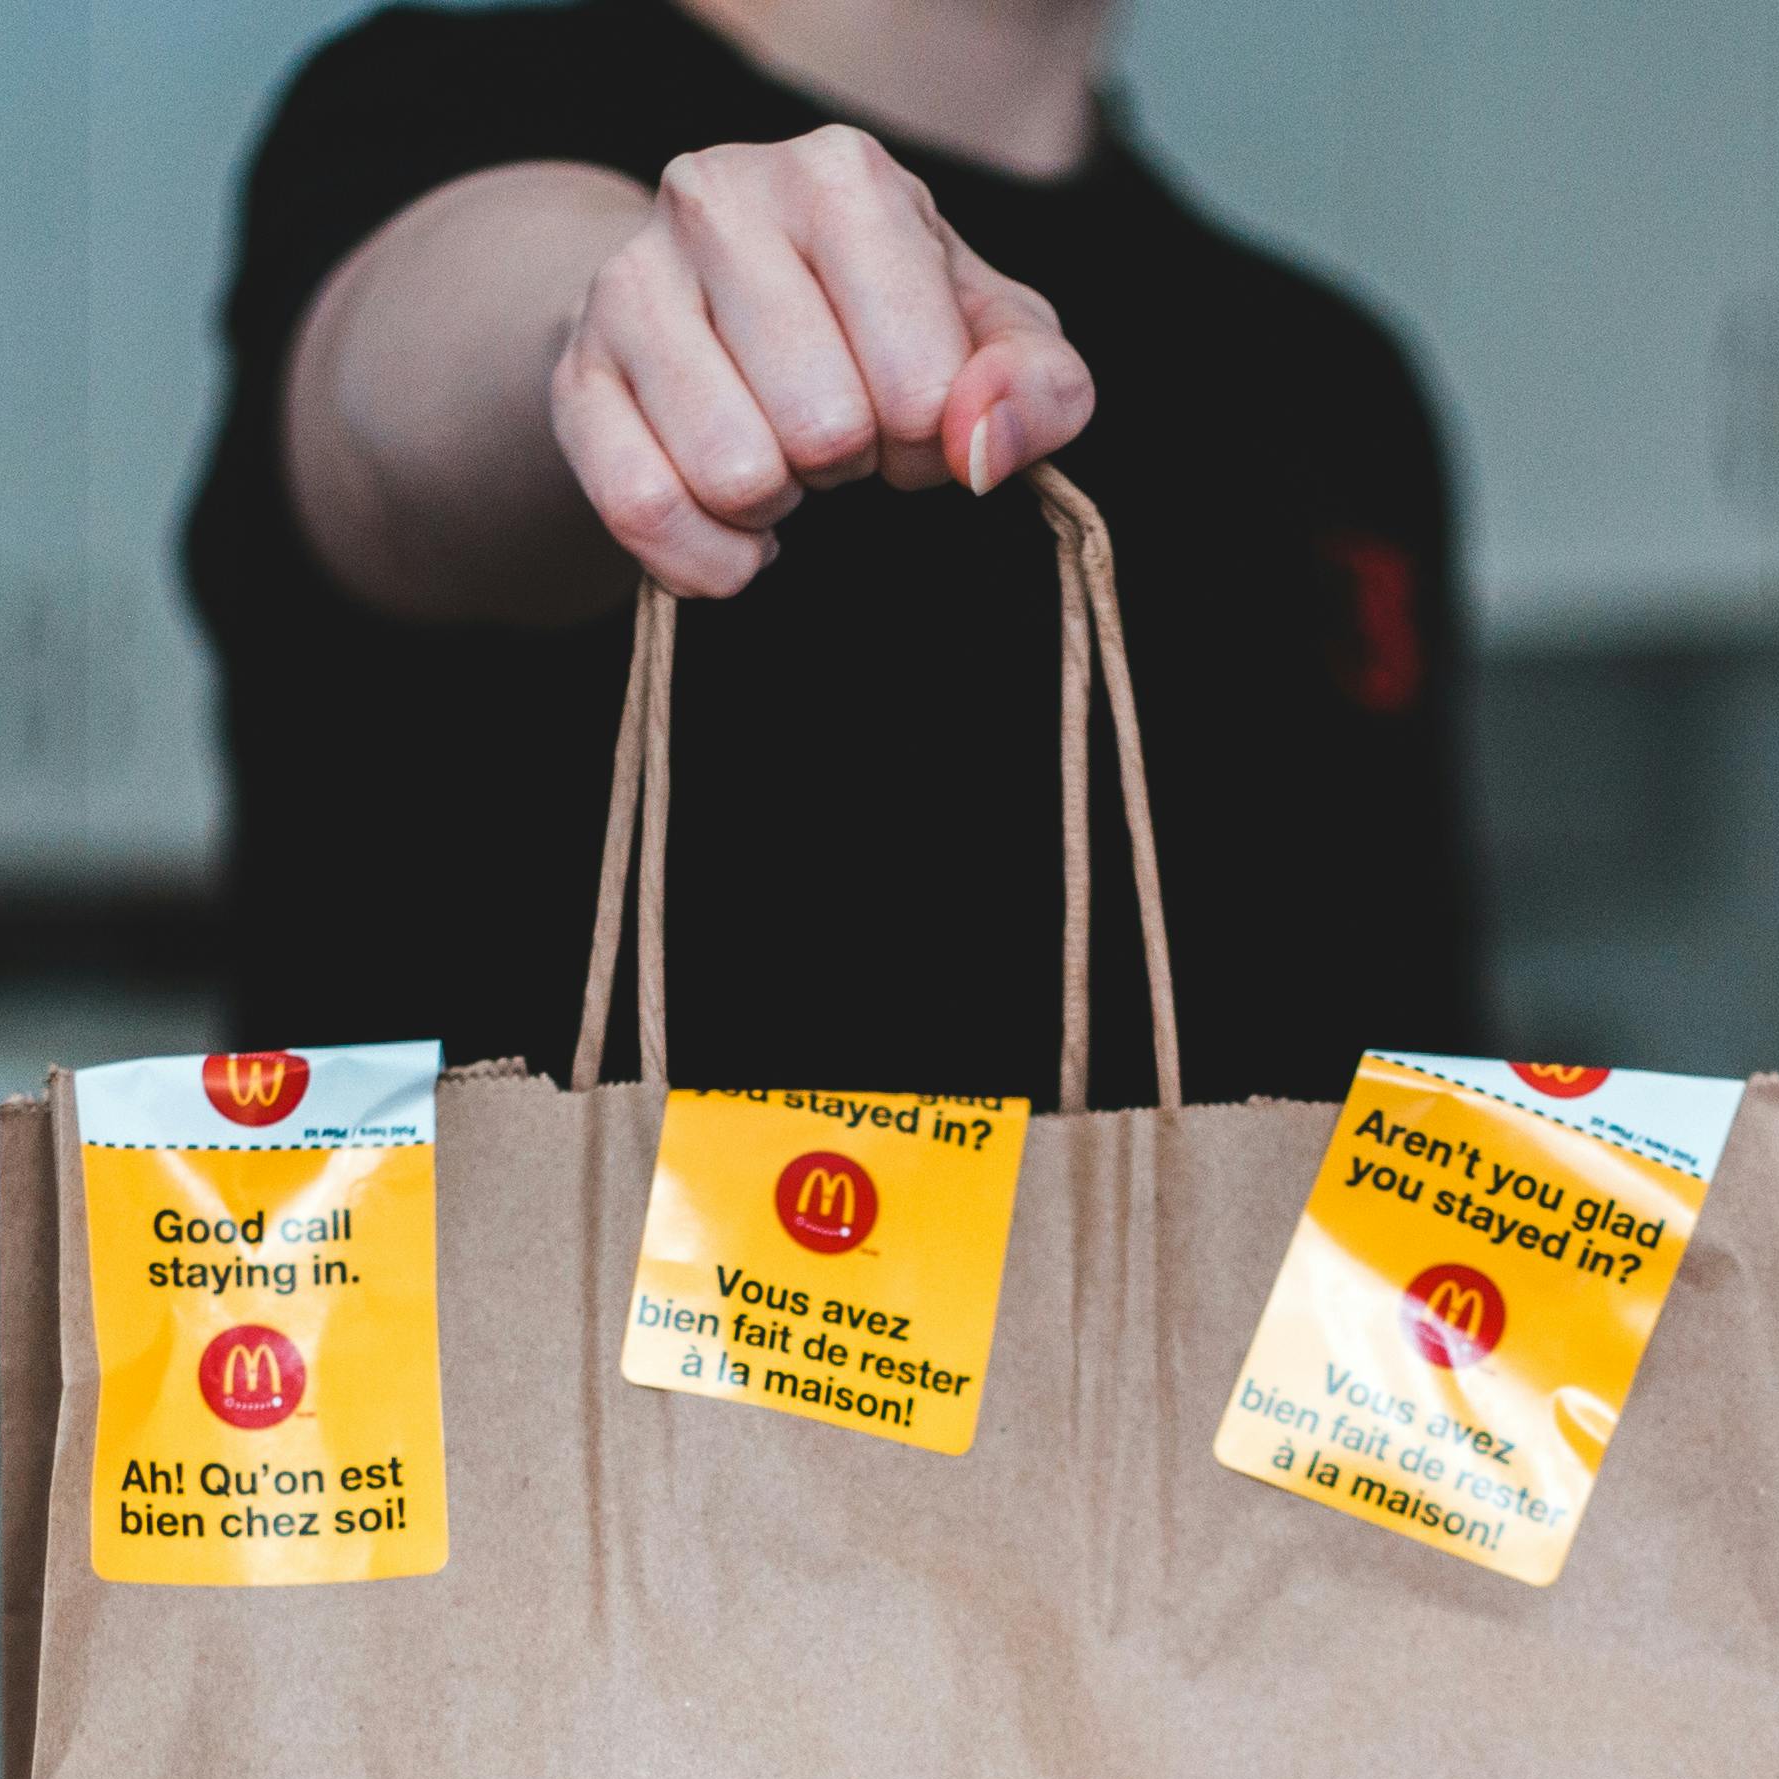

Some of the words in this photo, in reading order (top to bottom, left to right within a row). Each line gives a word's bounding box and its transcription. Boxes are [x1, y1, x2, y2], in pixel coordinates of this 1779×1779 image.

[783, 1090, 920, 1135] stayed
[932, 1110, 991, 1151] in?
[1346, 1155, 1424, 1202] you
[1432, 1187, 1571, 1260] stayed
[1577, 1240, 1643, 1286] in?
[1354, 1109, 1481, 1180] Aren't
[1485, 1159, 1565, 1212] you
[1571, 1195, 1666, 1249] glad
[153, 1209, 265, 1244] Good
[280, 1209, 352, 1243] call
[148, 1256, 297, 1295] staying
[312, 1256, 361, 1287] in.
[716, 1265, 810, 1317] Vous
[821, 1299, 910, 1341] avez
[637, 1295, 719, 1338] bien
[732, 1313, 792, 1354] fait
[803, 1333, 849, 1367] de
[860, 1351, 971, 1397] rester
[680, 1345, 702, 1379] à
[717, 1351, 750, 1387] la
[764, 1367, 915, 1428] maison!
[1238, 1378, 1320, 1434] bien
[1329, 1414, 1391, 1463] fait
[1399, 1440, 1446, 1482] de
[1455, 1469, 1568, 1529] rester
[1325, 1362, 1416, 1424] Vous
[1427, 1409, 1517, 1465] avez
[120, 1459, 185, 1495] Ah!
[200, 1461, 324, 1498] Qu'on
[339, 1456, 404, 1489] est
[120, 1502, 205, 1537] bien
[220, 1505, 320, 1538] chez
[334, 1499, 407, 1533] soi!
[1271, 1437, 1296, 1471] à
[1306, 1449, 1340, 1488] la
[1350, 1475, 1505, 1550] maison!
